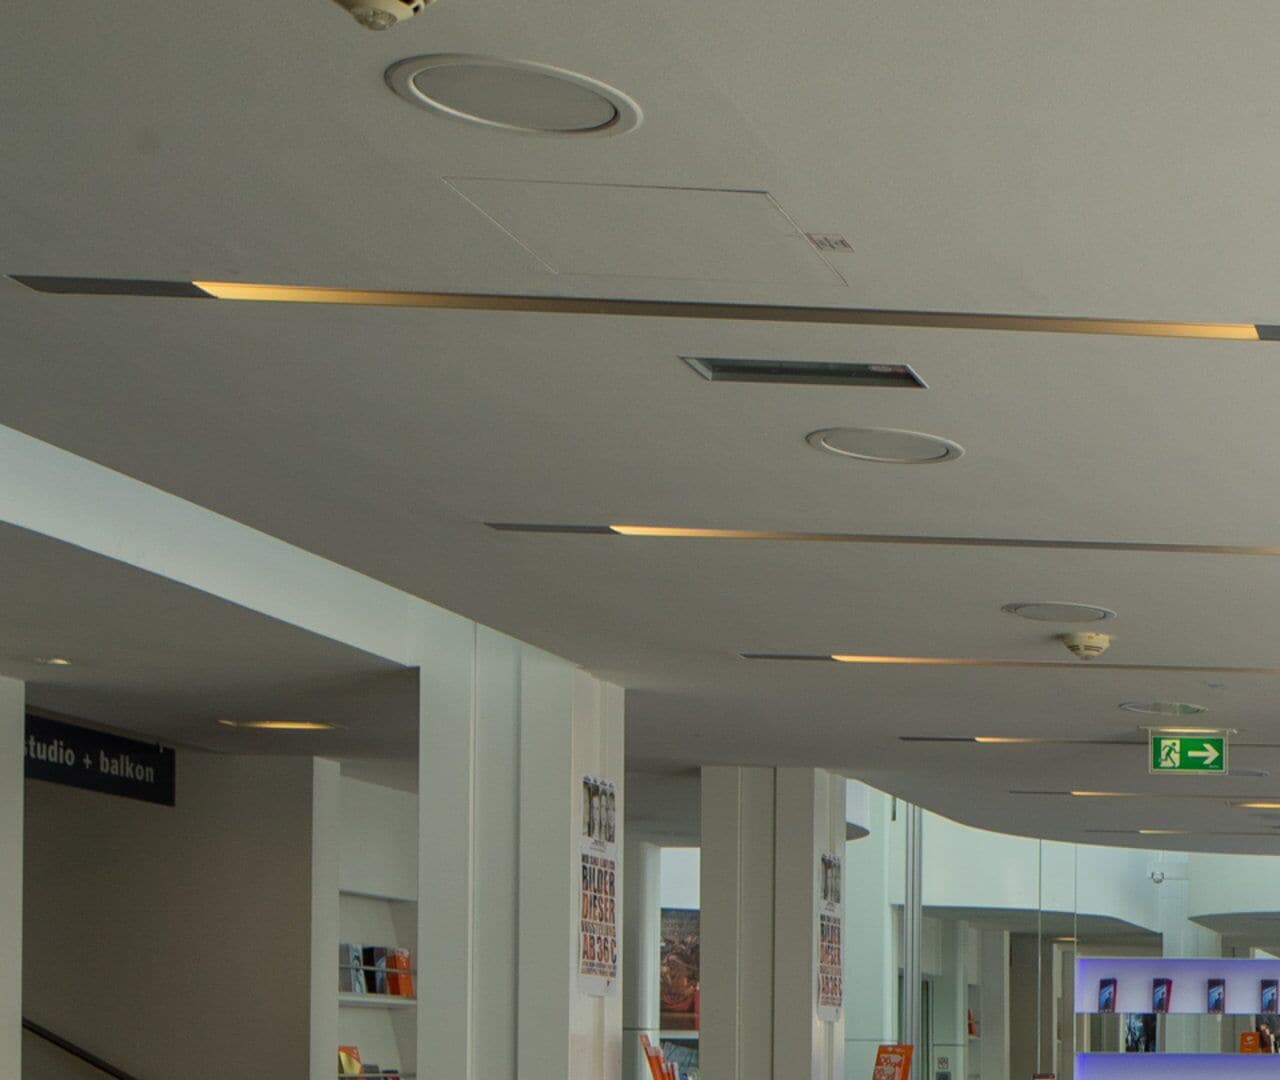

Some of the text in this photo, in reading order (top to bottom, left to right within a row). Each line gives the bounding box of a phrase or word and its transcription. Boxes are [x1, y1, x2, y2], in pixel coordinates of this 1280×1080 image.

[100, 749, 155, 783] balkon
[582, 864, 615, 897] BILDER
[582, 893, 615, 925] DIESER
[582, 932, 596, 960] AB
